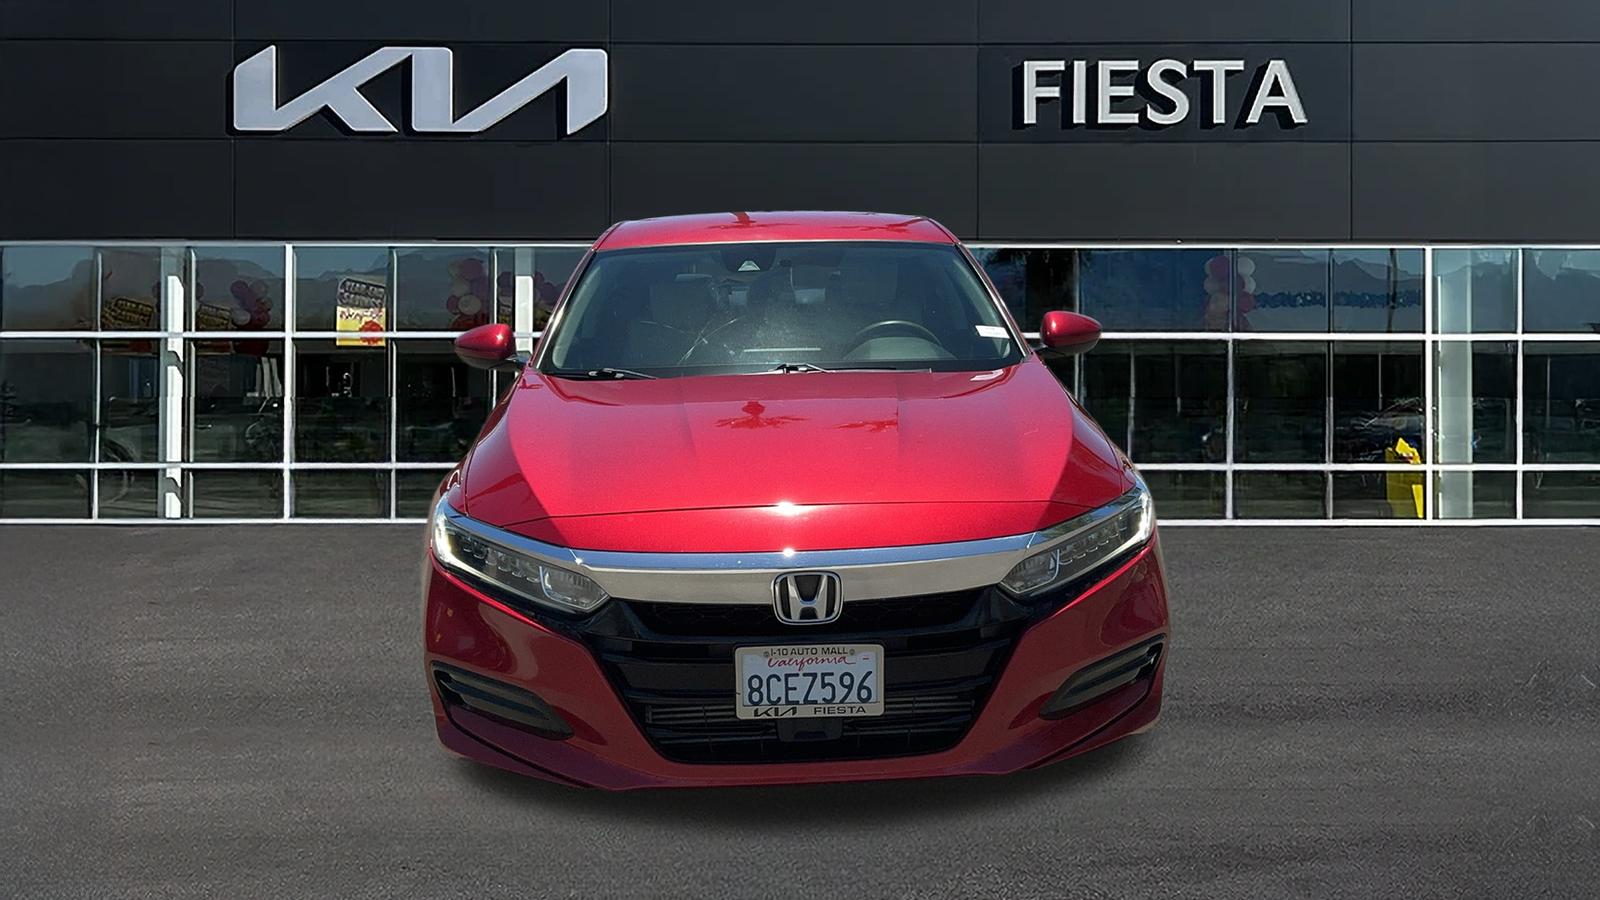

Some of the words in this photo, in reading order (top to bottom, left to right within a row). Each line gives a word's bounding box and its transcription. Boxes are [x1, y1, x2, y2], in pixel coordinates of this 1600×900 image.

[233, 44, 608, 135] KIA
[1023, 58, 1308, 125] FIESTA
[767, 655, 856, 671] California
[770, 648, 788, 656] I-10
[790, 648, 818, 656] AUTO
[821, 647, 848, 655] MALL
[747, 670, 873, 706] 8CEZ596
[813, 706, 866, 715] FIESTA
